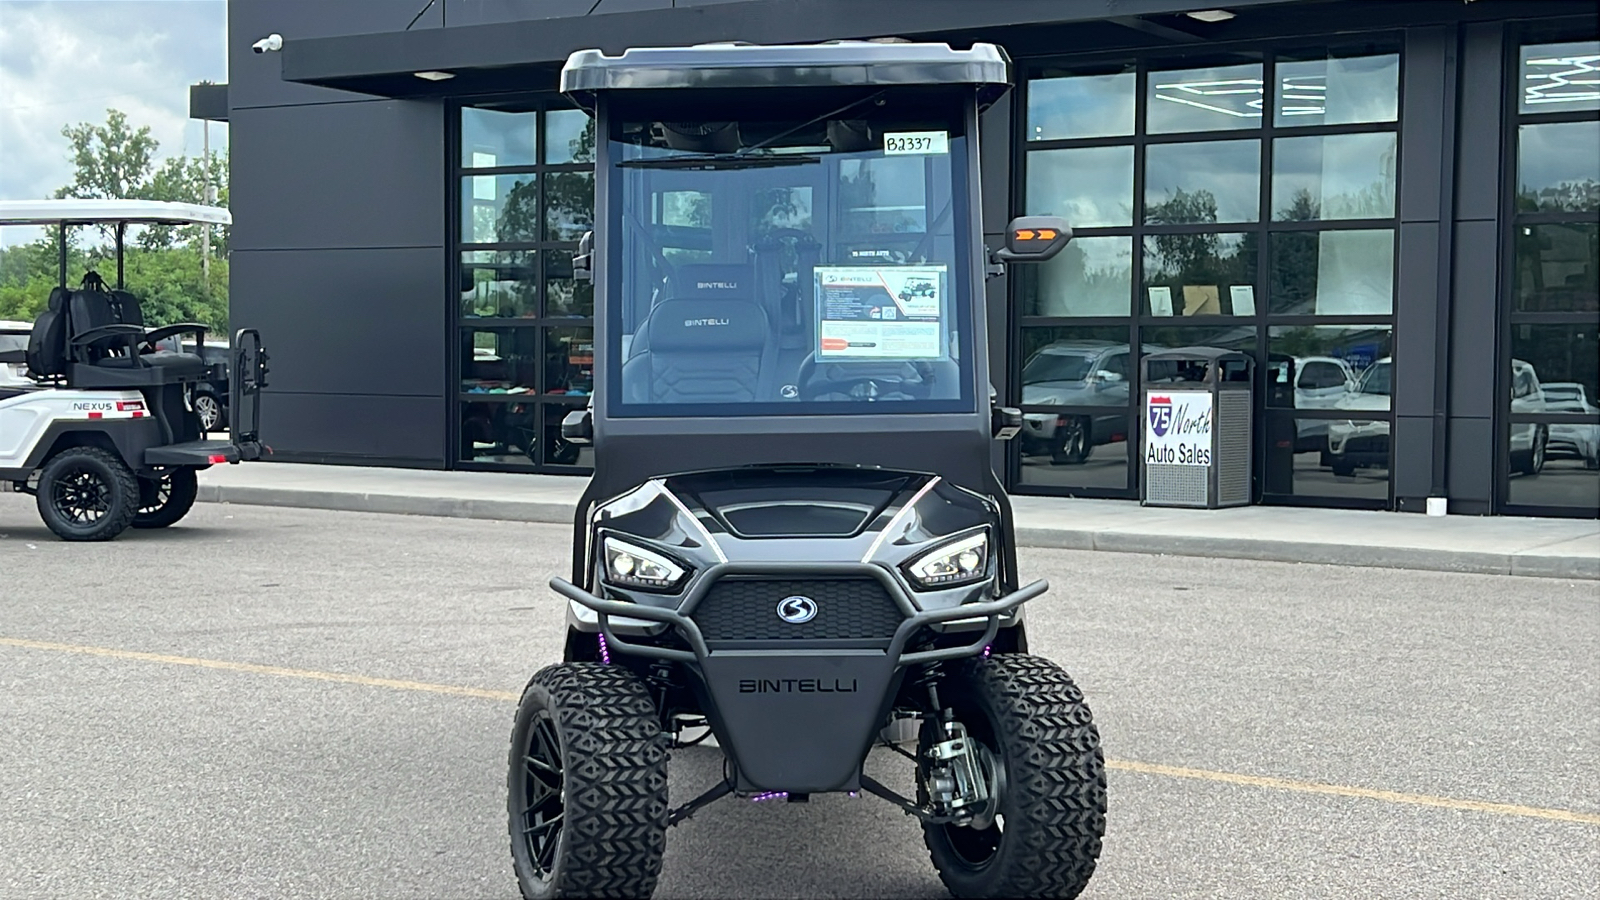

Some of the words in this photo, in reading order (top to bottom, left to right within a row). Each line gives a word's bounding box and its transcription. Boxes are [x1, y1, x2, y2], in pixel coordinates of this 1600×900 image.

[887, 137, 931, 151] B2337
[684, 318, 729, 327] BINTELLI
[73, 402, 112, 411] NEXUS
[1152, 407, 1170, 429] 75
[1170, 402, 1212, 435] North
[1147, 442, 1175, 463] Auto
[1178, 442, 1210, 465] Sales
[739, 678, 858, 693] BINTELLI
